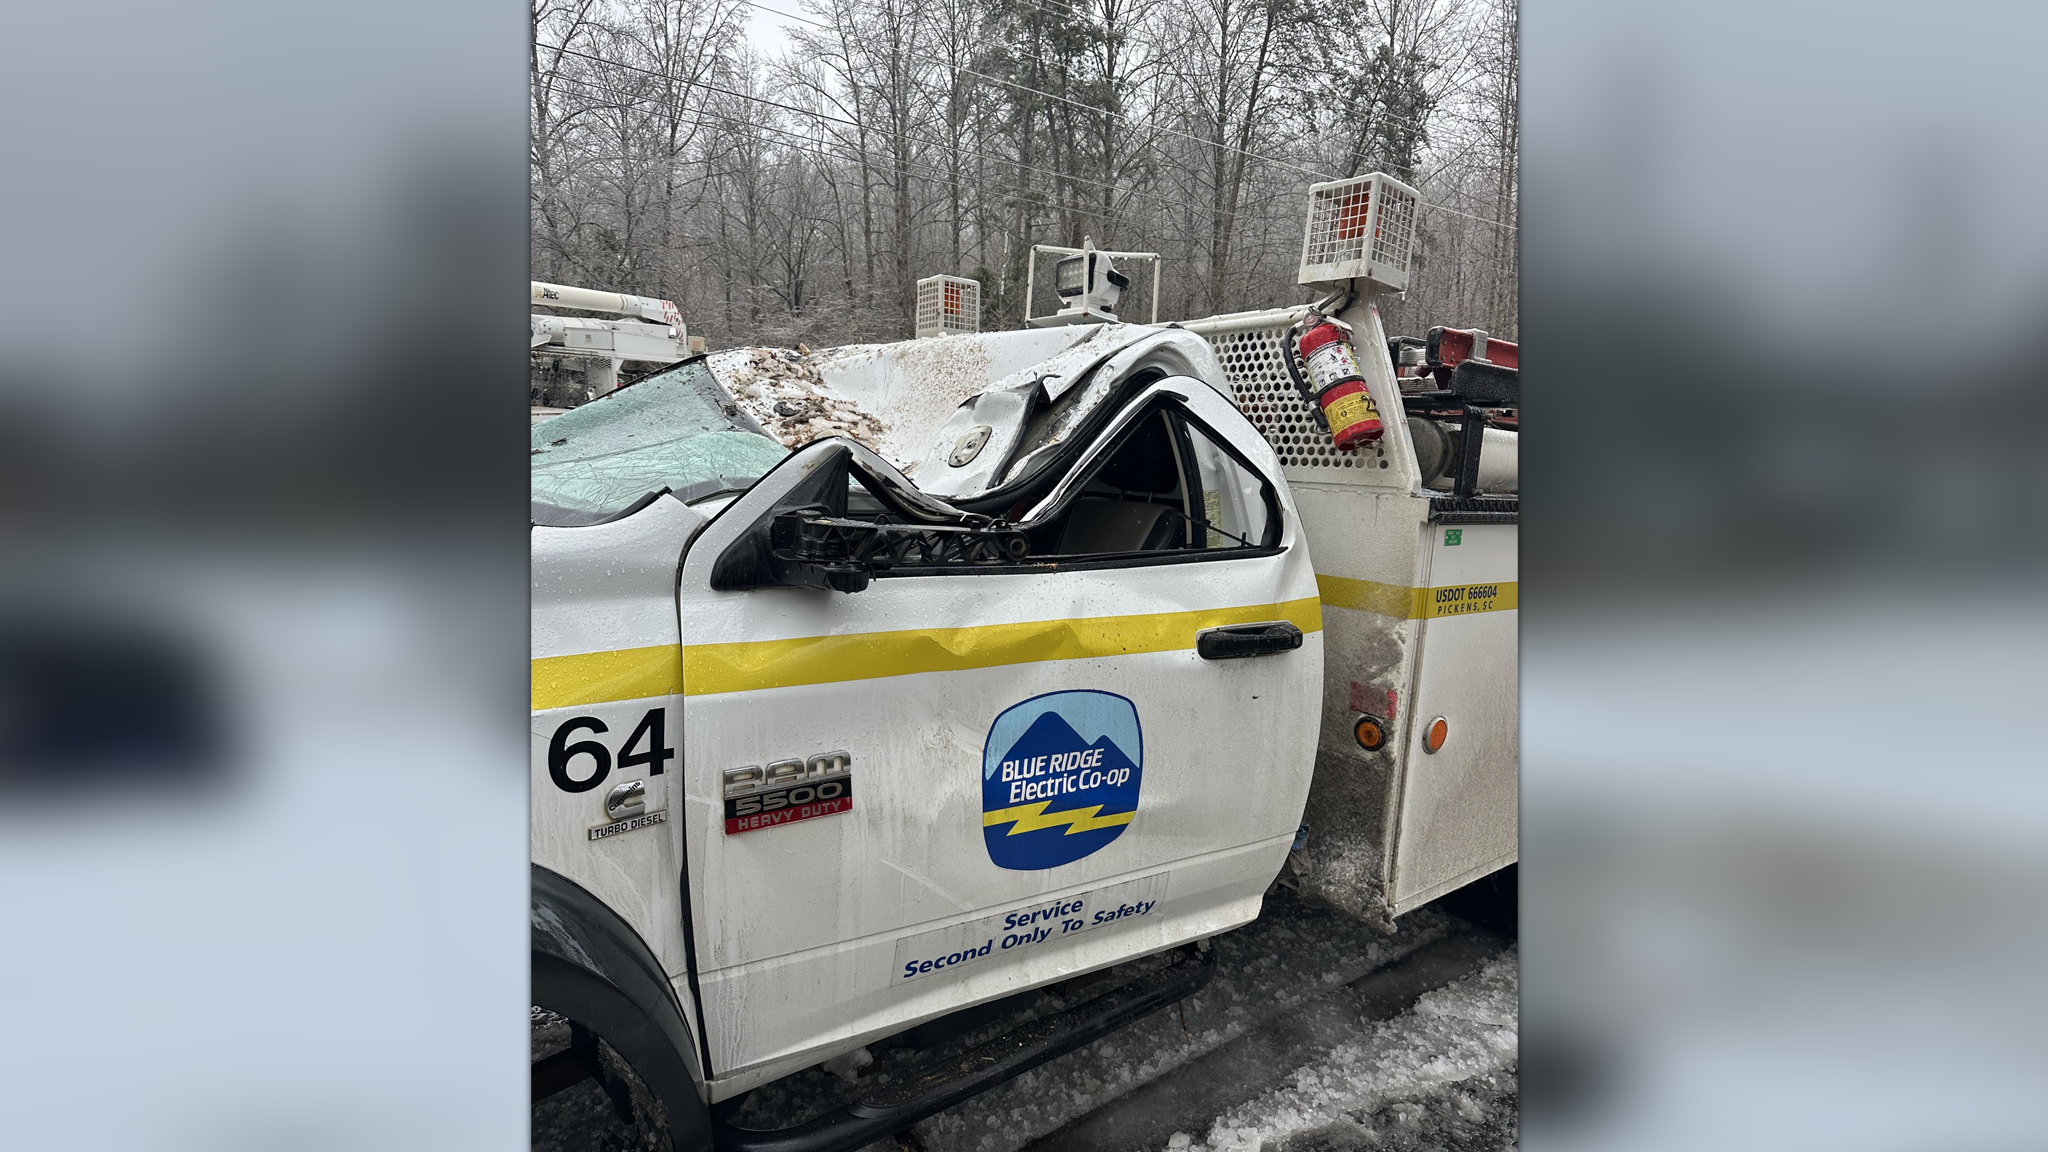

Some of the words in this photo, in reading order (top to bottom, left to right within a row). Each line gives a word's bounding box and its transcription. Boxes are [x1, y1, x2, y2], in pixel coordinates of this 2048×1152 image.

[1436, 587, 1466, 603] USDOT
[1468, 585, 1497, 600] 666604
[1437, 602, 1480, 615] PICKENS,
[1483, 600, 1493, 610] SC
[548, 707, 675, 793] 64
[1001, 755, 1048, 783] BLUE
[1049, 748, 1105, 773] RIDGE
[723, 750, 851, 796] RAM
[1009, 773, 1077, 804] Electric
[1079, 767, 1130, 790] Co-op
[735, 782, 843, 816] 5500
[738, 809, 794, 831] HEAVY
[801, 800, 842, 818] DUTY
[595, 822, 628, 838] TURBO
[631, 813, 663, 829] DIESEL
[1003, 900, 1084, 931] Service
[903, 939, 994, 979] Second
[1001, 926, 1053, 950] Only
[1061, 918, 1084, 934] To
[1091, 899, 1157, 926] Safety
